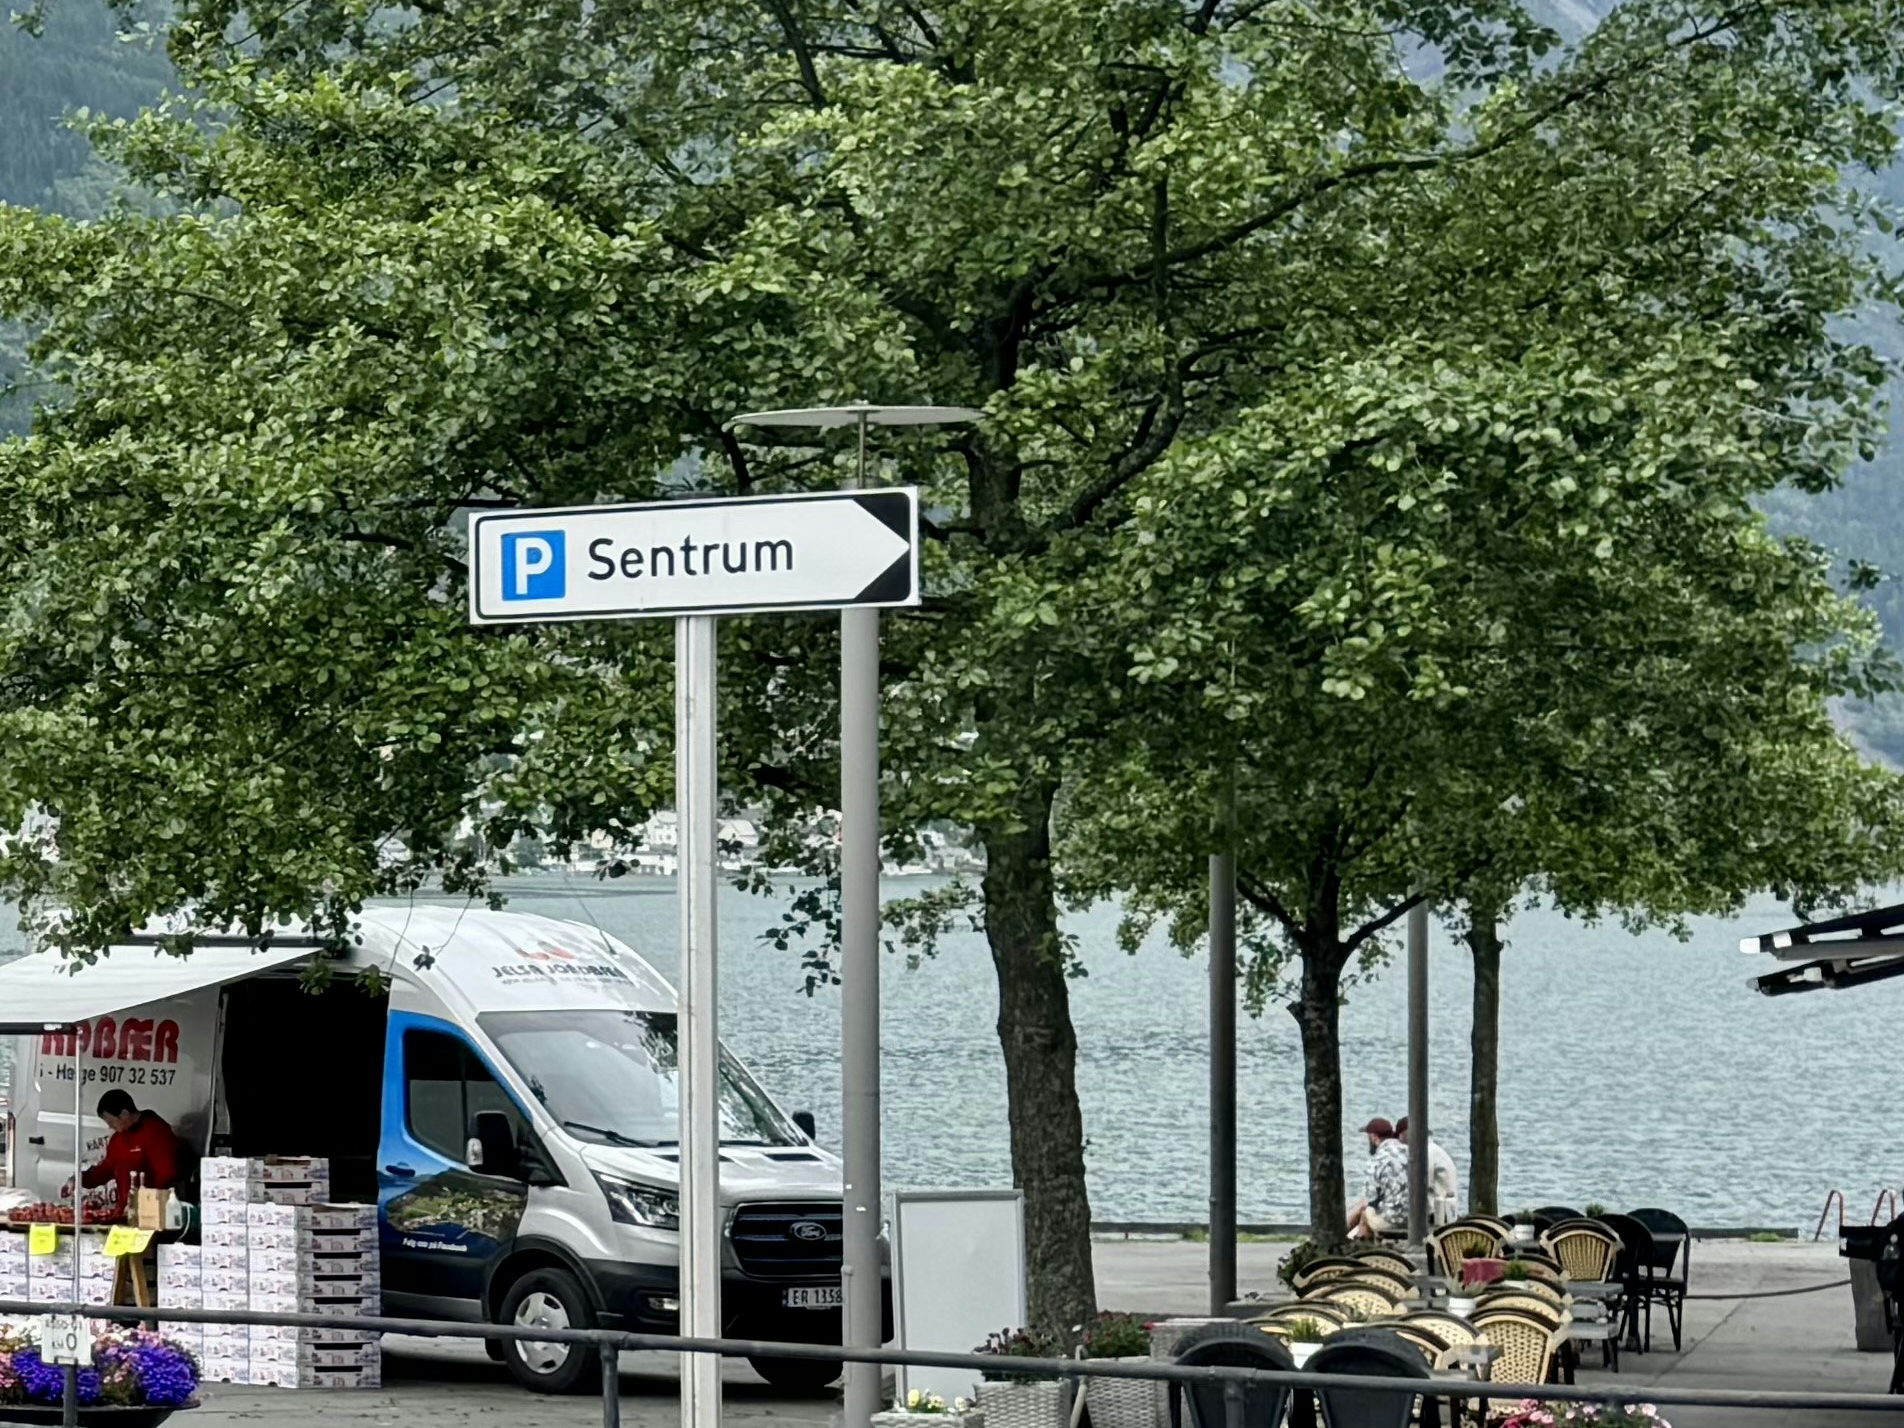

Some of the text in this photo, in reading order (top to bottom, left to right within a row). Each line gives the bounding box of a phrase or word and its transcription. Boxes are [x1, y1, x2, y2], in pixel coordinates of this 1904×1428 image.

[515, 534, 793, 595] P Sentrum
[100, 1065, 124, 1083] 907
[129, 1067, 145, 1084] 32
[150, 1069, 176, 1085] 537
[793, 1289, 808, 1305] ER
